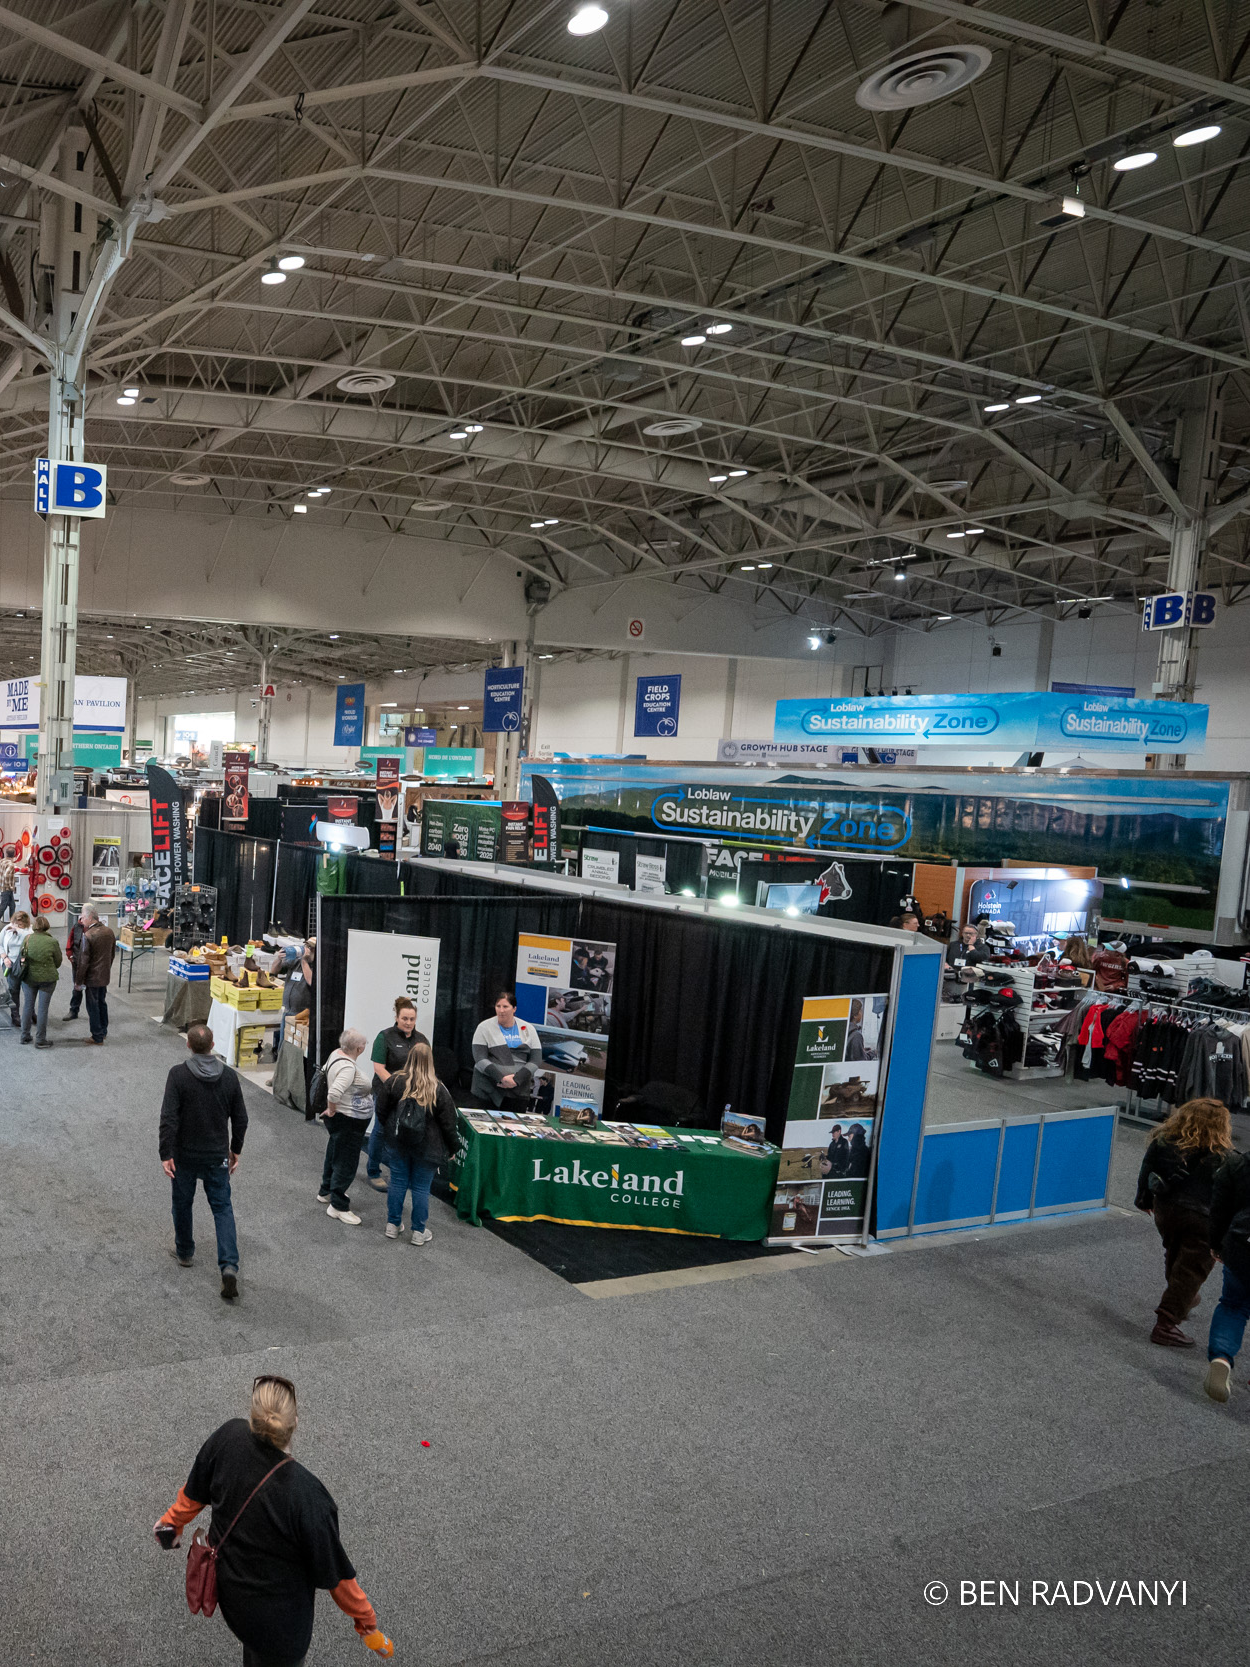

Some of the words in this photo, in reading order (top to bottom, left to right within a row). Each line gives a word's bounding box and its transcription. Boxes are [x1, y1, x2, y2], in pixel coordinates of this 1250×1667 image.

[39, 461, 48, 511] HALL
[52, 464, 102, 511] B
[1153, 595, 1184, 627] B
[1192, 594, 1216, 624] B
[7, 680, 29, 697] MADE
[264, 685, 275, 696] A
[647, 685, 669, 693] FIELD
[86, 699, 121, 708] PAVILION
[644, 693, 670, 701] CROPS
[11, 697, 29, 712] ME
[830, 704, 865, 712] Loblaw
[1083, 701, 1109, 712] Loblaw
[809, 714, 930, 733] Sustainability
[933, 713, 988, 729] Zone
[1066, 713, 1149, 738] Sustainability
[1150, 719, 1182, 737] Zone
[741, 743, 777, 751] GROWTH
[780, 744, 798, 752] HUB
[687, 787, 731, 800] Loblaw
[172, 801, 181, 840] WASHING
[661, 801, 814, 838] Sustainability
[819, 813, 896, 840] Zone
[453, 823, 469, 833] Zero
[428, 842, 442, 852] 2040
[174, 842, 182, 873] POWER
[479, 852, 493, 860] 2025
[709, 869, 737, 880] MOBILE
[528, 953, 560, 962] Lakeland
[422, 957, 432, 1003] COLLEGE
[806, 1043, 836, 1052] Lakeland
[532, 1158, 684, 1196] Lakeland
[610, 1193, 681, 1209] COLLEGE
